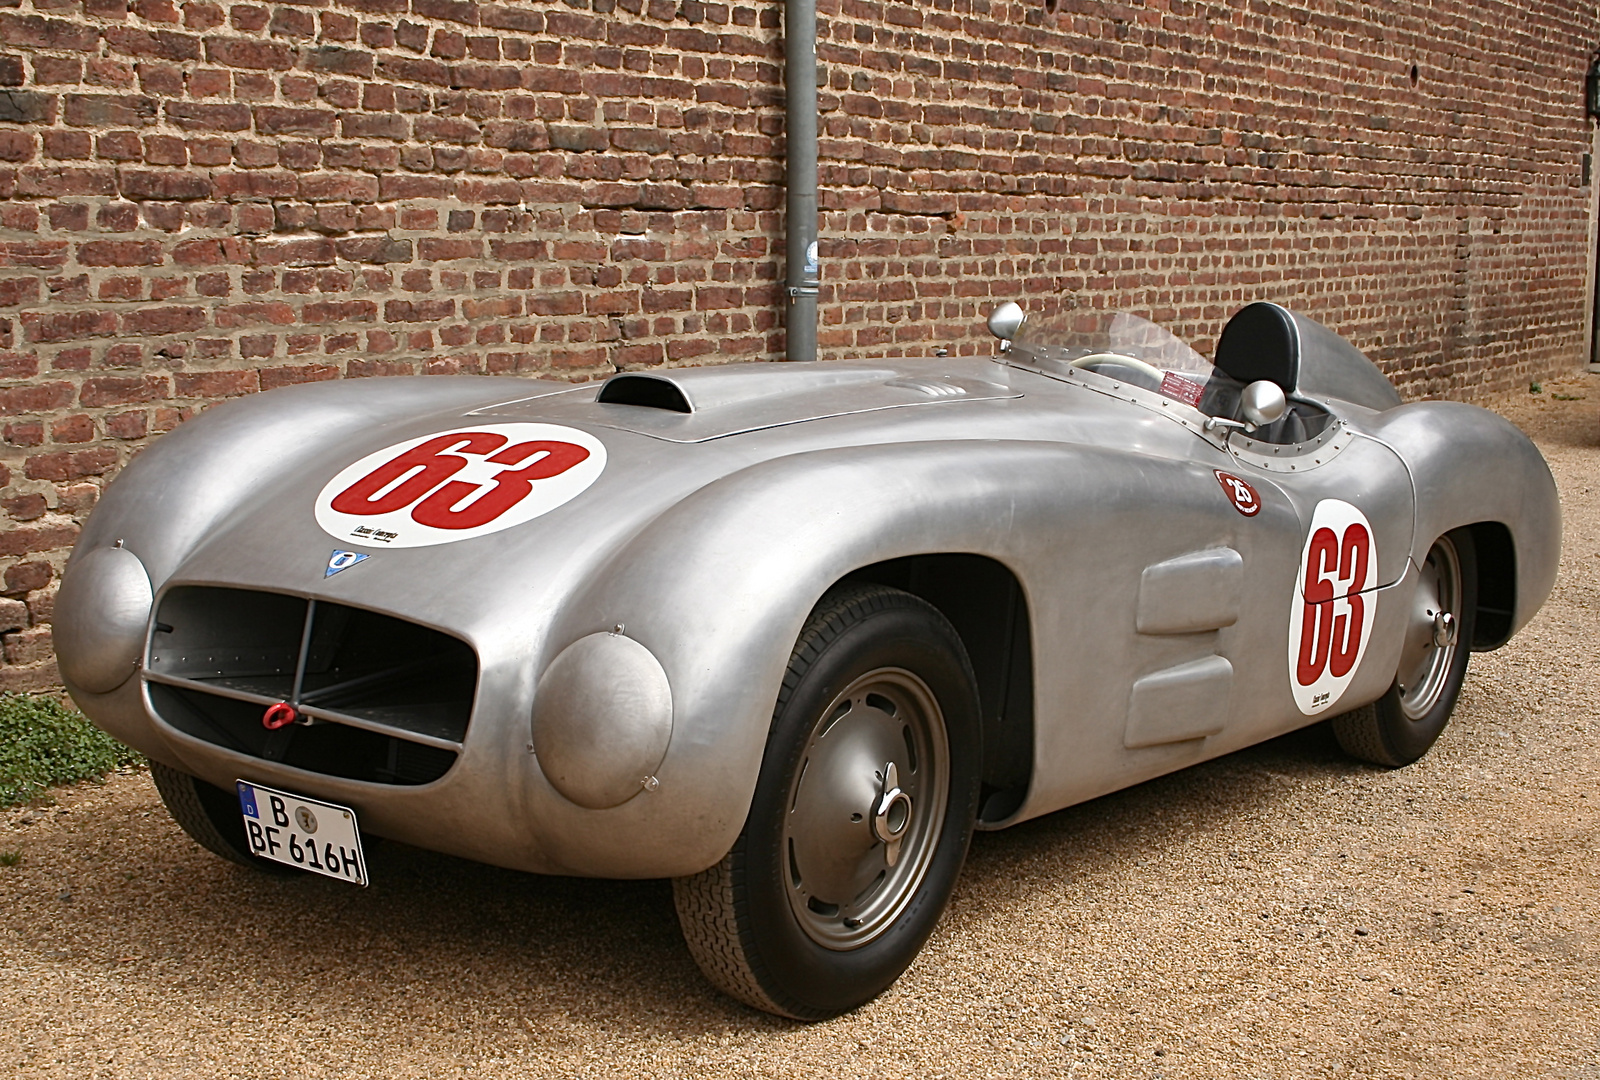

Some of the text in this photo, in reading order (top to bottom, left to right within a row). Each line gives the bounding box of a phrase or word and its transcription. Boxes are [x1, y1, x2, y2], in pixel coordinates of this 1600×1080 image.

[330, 431, 591, 530] 63
[1225, 478, 1253, 503] 26
[1296, 523, 1370, 687] 63
[246, 804, 254, 815] D
[270, 795, 290, 828] B
[247, 819, 361, 879] BF 616H
